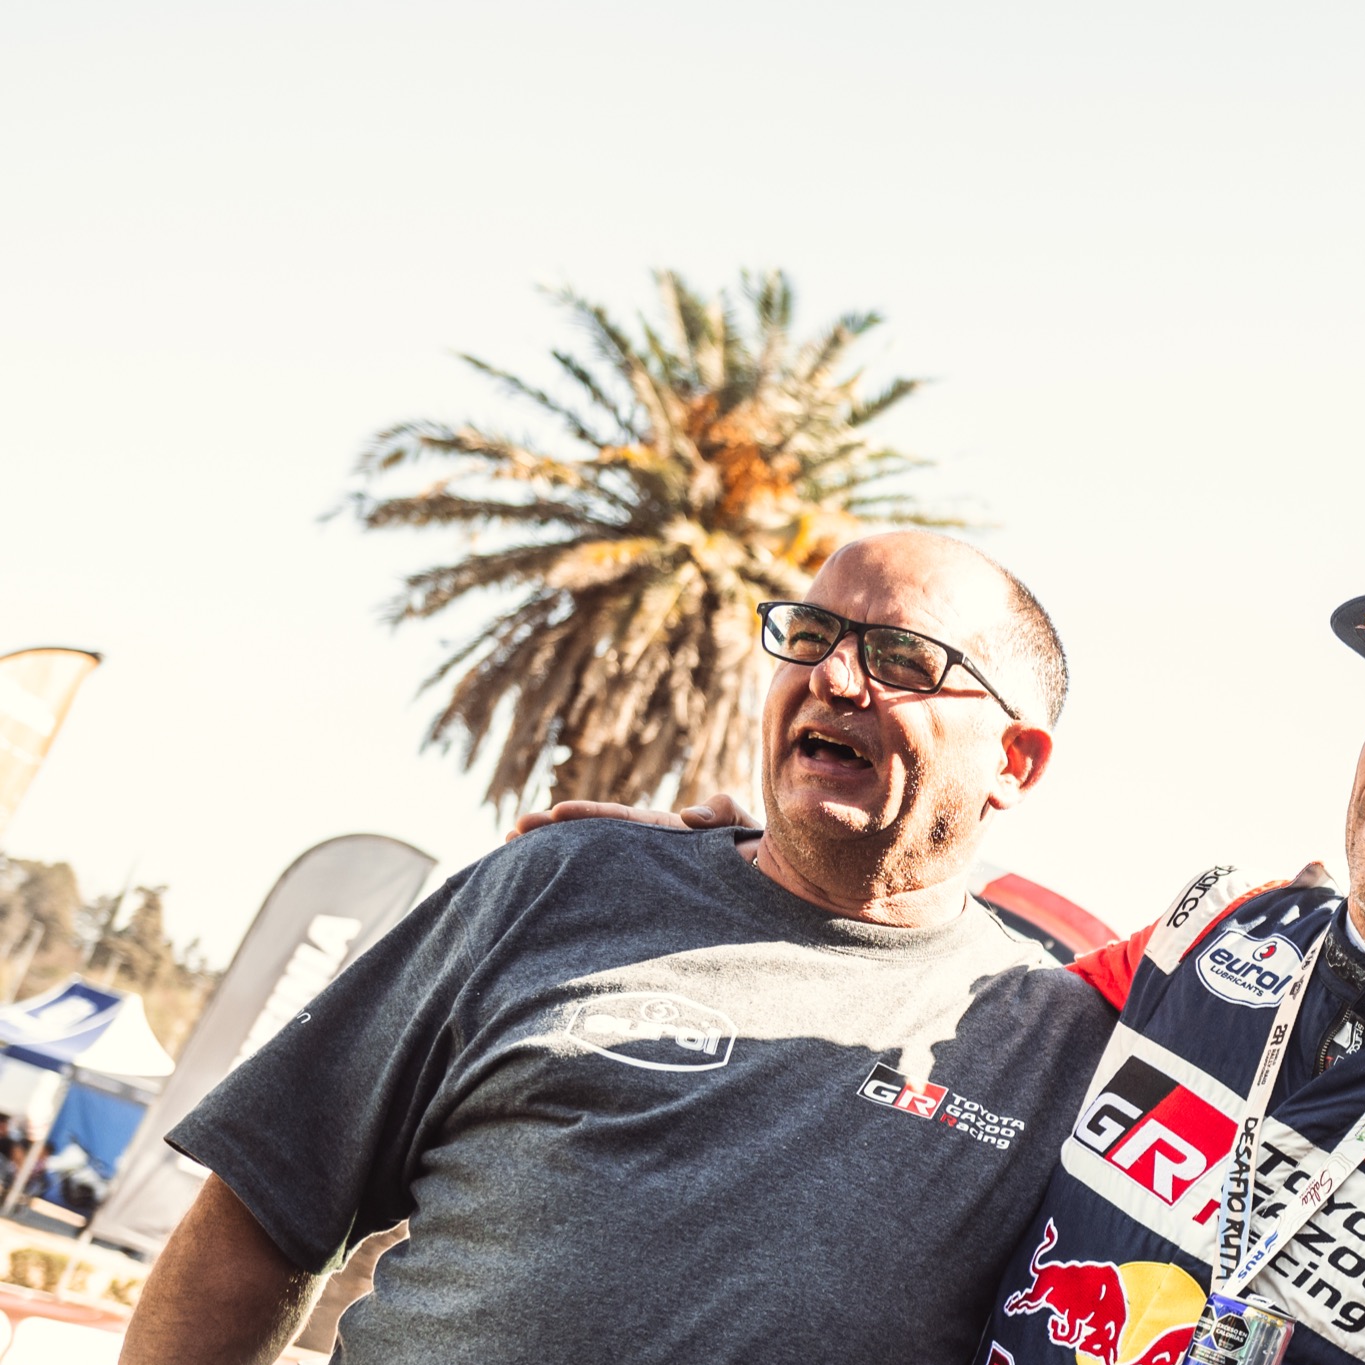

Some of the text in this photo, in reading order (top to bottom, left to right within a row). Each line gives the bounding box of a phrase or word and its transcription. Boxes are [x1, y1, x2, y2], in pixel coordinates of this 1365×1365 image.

[1208, 946, 1293, 996] eurol
[1210, 966, 1264, 997] LUBRICANTS
[863, 1079, 937, 1116] GR
[952, 1092, 1026, 1131] TOYOTA
[939, 1112, 1011, 1149] Racing
[945, 1103, 1016, 1138] GAZOO
[1075, 1091, 1208, 1202] GR
[1227, 1116, 1259, 1213] DESAFIO
[1238, 1250, 1265, 1280] RUS
